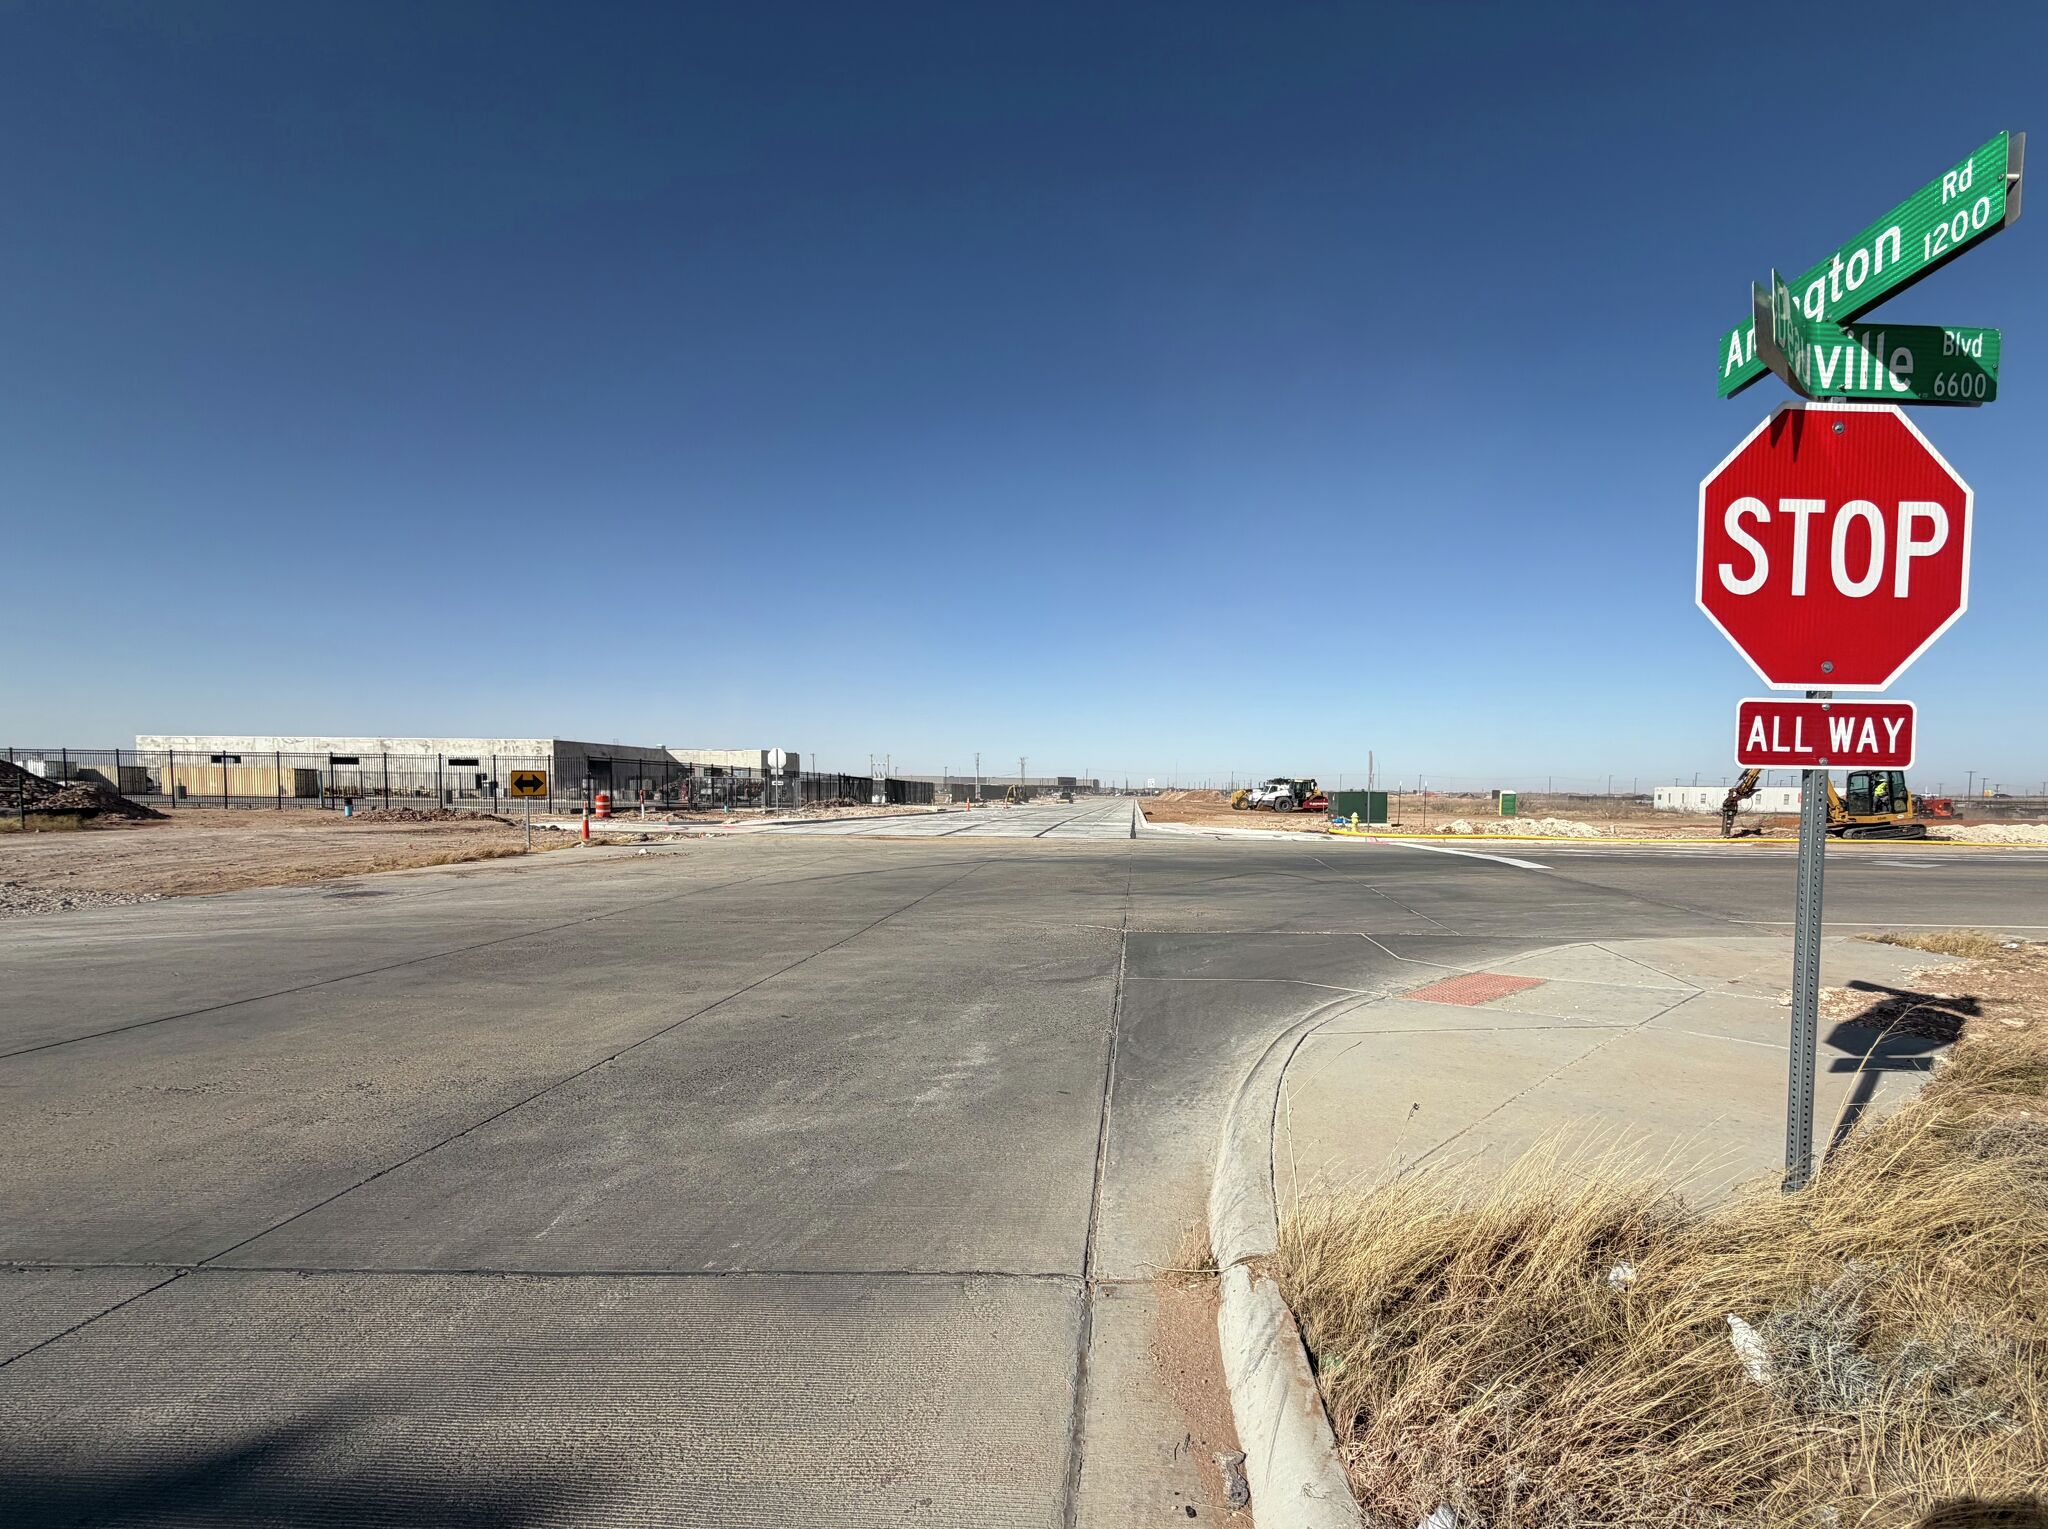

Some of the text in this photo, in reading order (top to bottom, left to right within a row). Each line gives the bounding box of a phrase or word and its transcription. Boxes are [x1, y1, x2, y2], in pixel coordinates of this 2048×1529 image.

[1923, 197, 1990, 261] 1200
[1724, 158, 1973, 378] Argton Rd
[1943, 331, 1983, 358] Blvd
[1934, 372, 1987, 398] 6600
[1718, 496, 1949, 598] STOP
[1746, 715, 1905, 753] ALL WAY
